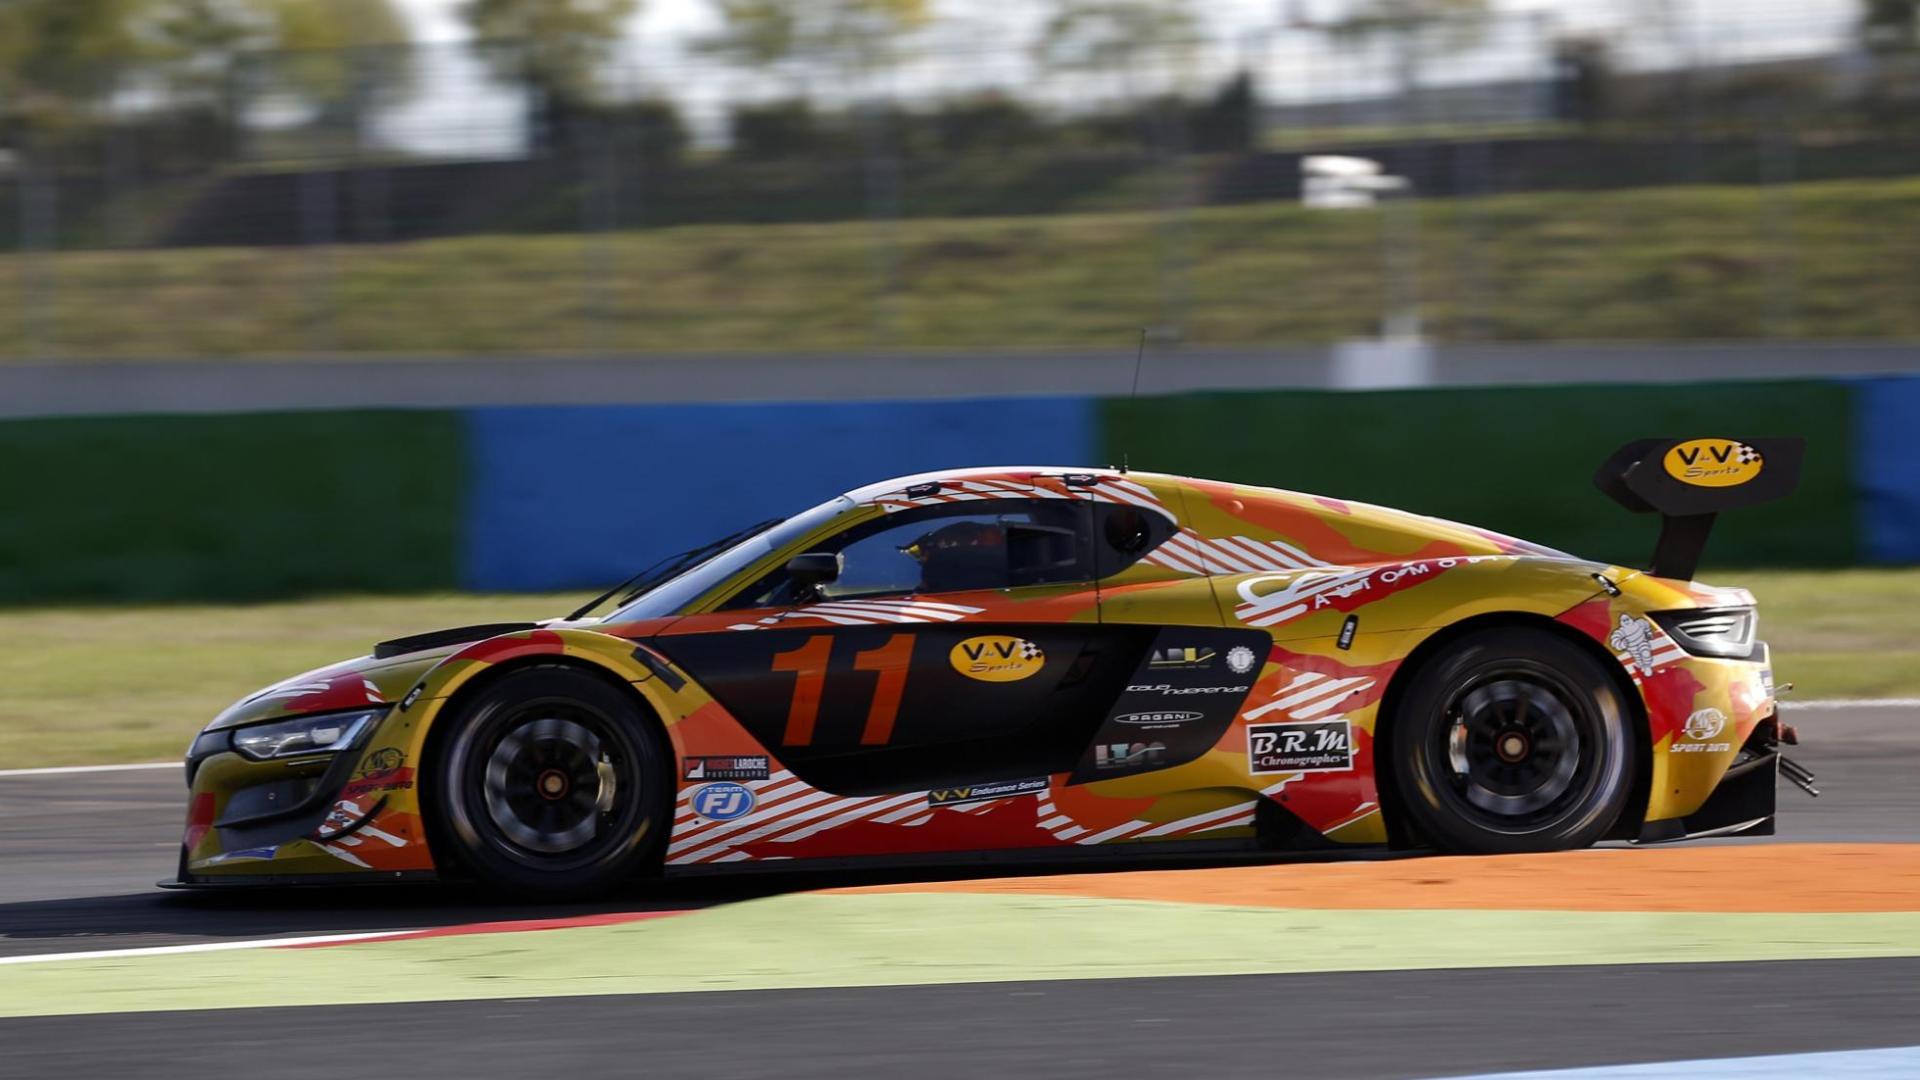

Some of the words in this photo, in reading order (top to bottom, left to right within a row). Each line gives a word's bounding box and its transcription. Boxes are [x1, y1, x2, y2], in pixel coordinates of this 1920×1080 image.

[1677, 446, 1700, 466] V
[1709, 444, 1732, 464] V
[963, 642, 985, 661] V
[994, 640, 1016, 659] V
[771, 633, 917, 746] 11
[1129, 713, 1191, 721] PAGANI
[733, 758, 767, 769] LAROCHE
[971, 784, 1017, 796] Endurance
[1018, 780, 1047, 790] Series
[702, 792, 743, 814] FJ
